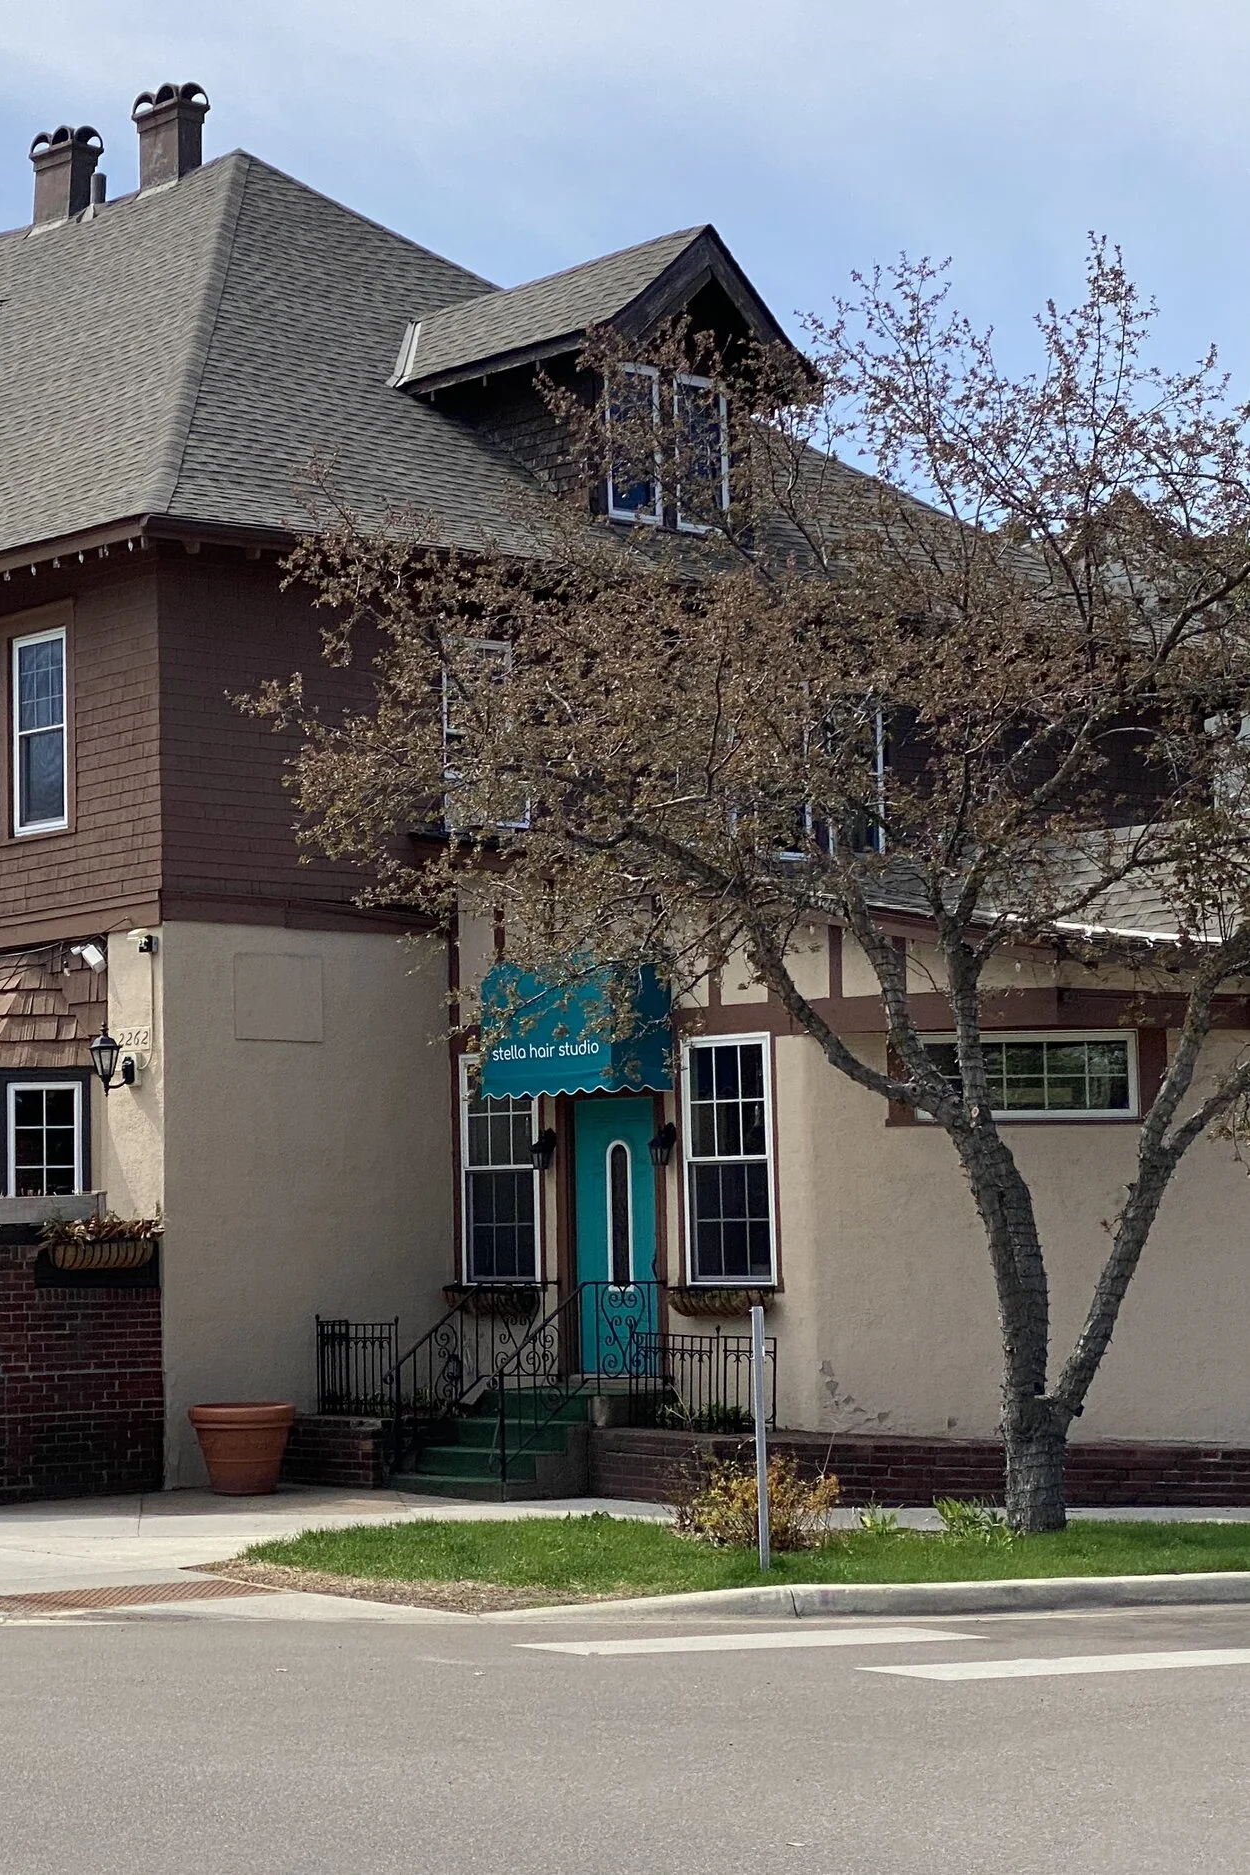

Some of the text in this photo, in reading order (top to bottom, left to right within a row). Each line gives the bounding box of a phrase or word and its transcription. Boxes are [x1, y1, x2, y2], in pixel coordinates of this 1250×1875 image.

[118, 1030, 149, 1046] 2262
[492, 1039, 600, 1061] stella hair studio
